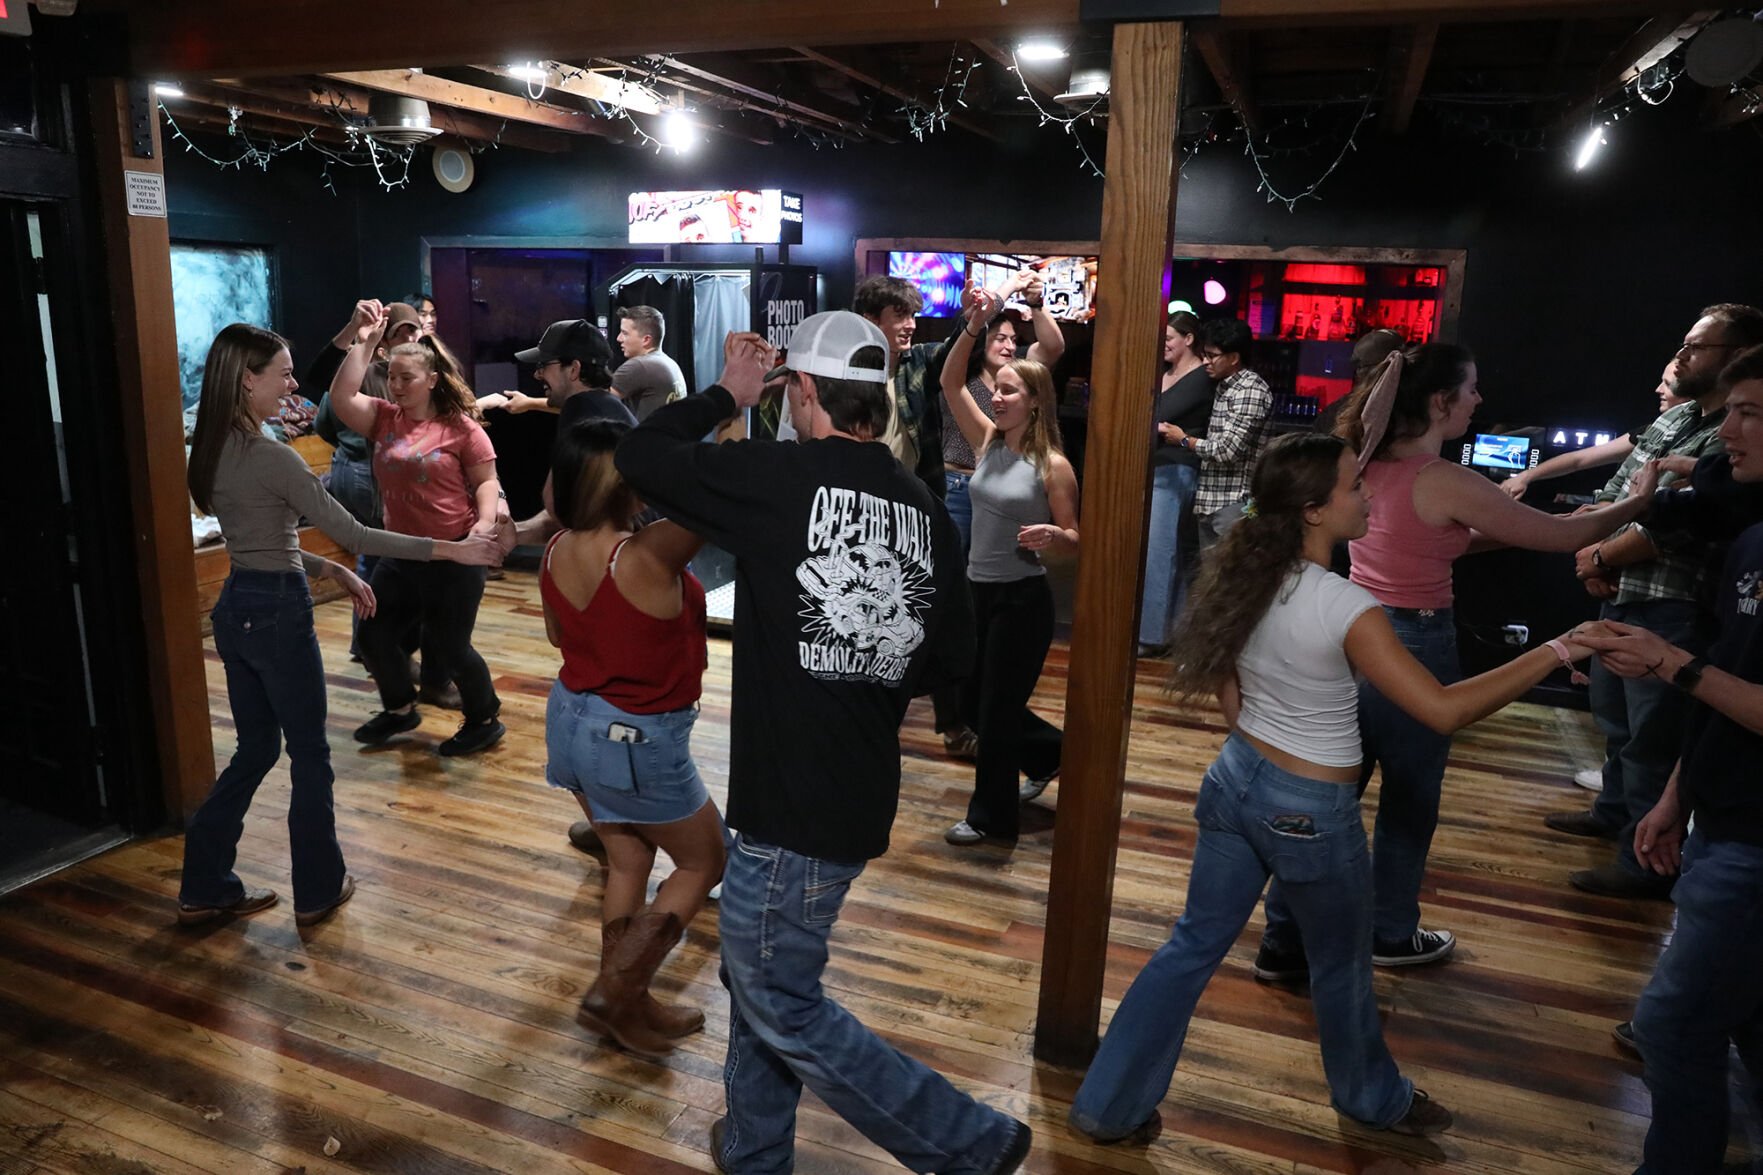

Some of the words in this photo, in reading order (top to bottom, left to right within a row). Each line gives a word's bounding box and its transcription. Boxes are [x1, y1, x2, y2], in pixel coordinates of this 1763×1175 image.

[129, 184, 160, 192] OCCUPANCY
[131, 177, 158, 185] MAXIMUM
[767, 300, 804, 325] PHOTO
[767, 325, 797, 350] BOO
[1552, 430, 1611, 446] ATM
[808, 486, 856, 552] OFF
[858, 491, 891, 547] THE
[892, 501, 935, 578] WALL
